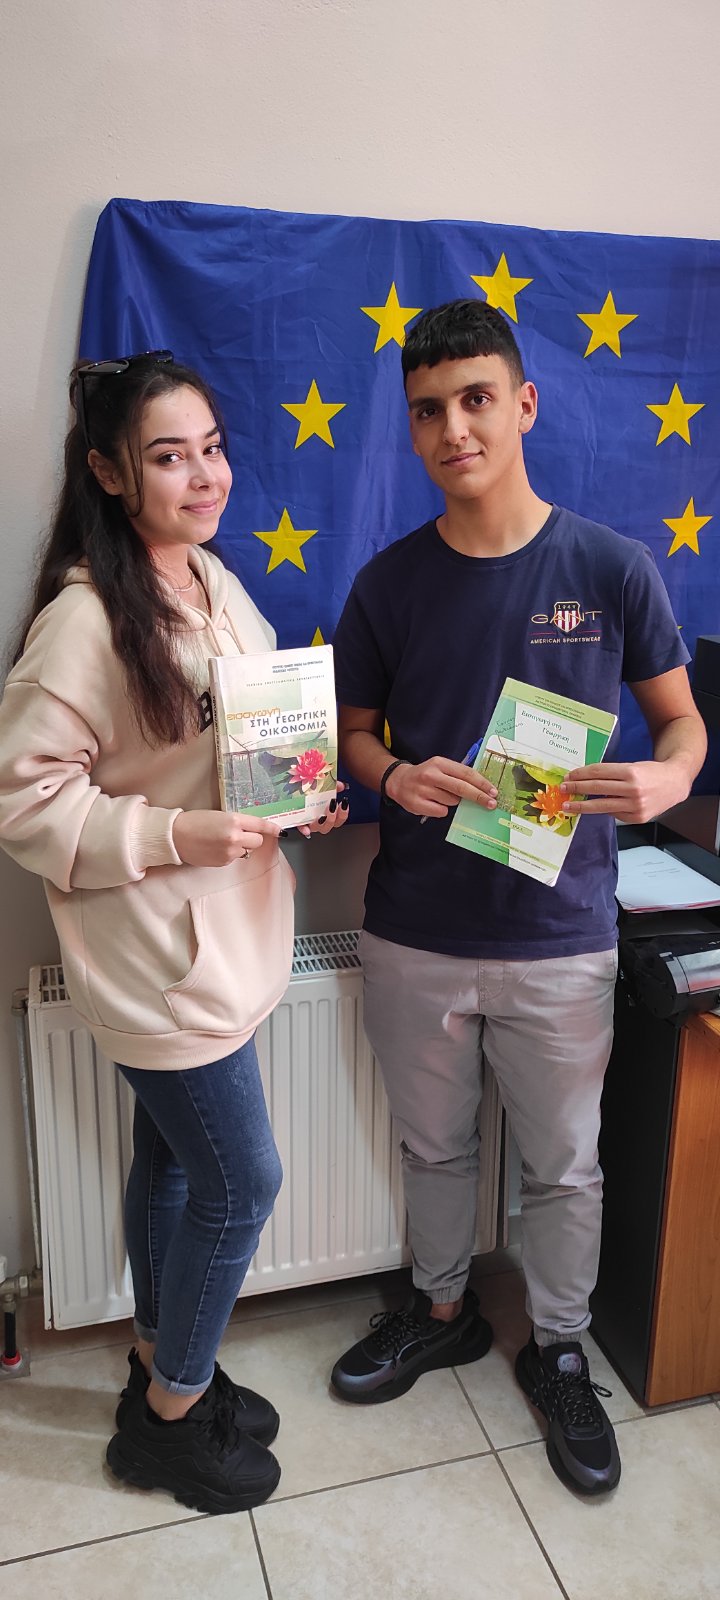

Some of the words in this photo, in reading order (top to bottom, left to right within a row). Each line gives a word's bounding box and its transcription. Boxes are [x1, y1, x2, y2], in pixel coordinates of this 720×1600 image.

[531, 610, 602, 624] GANT
[562, 636, 601, 644] SPORTSWEAR
[226, 706, 281, 721] εισαγωγή
[250, 717, 270, 728] ΣΤΗ
[276, 709, 327, 724] ΓΕΩΡΓΙΚΗ
[259, 720, 328, 737] ΟΙΚΟΝΟΜΙΑ
